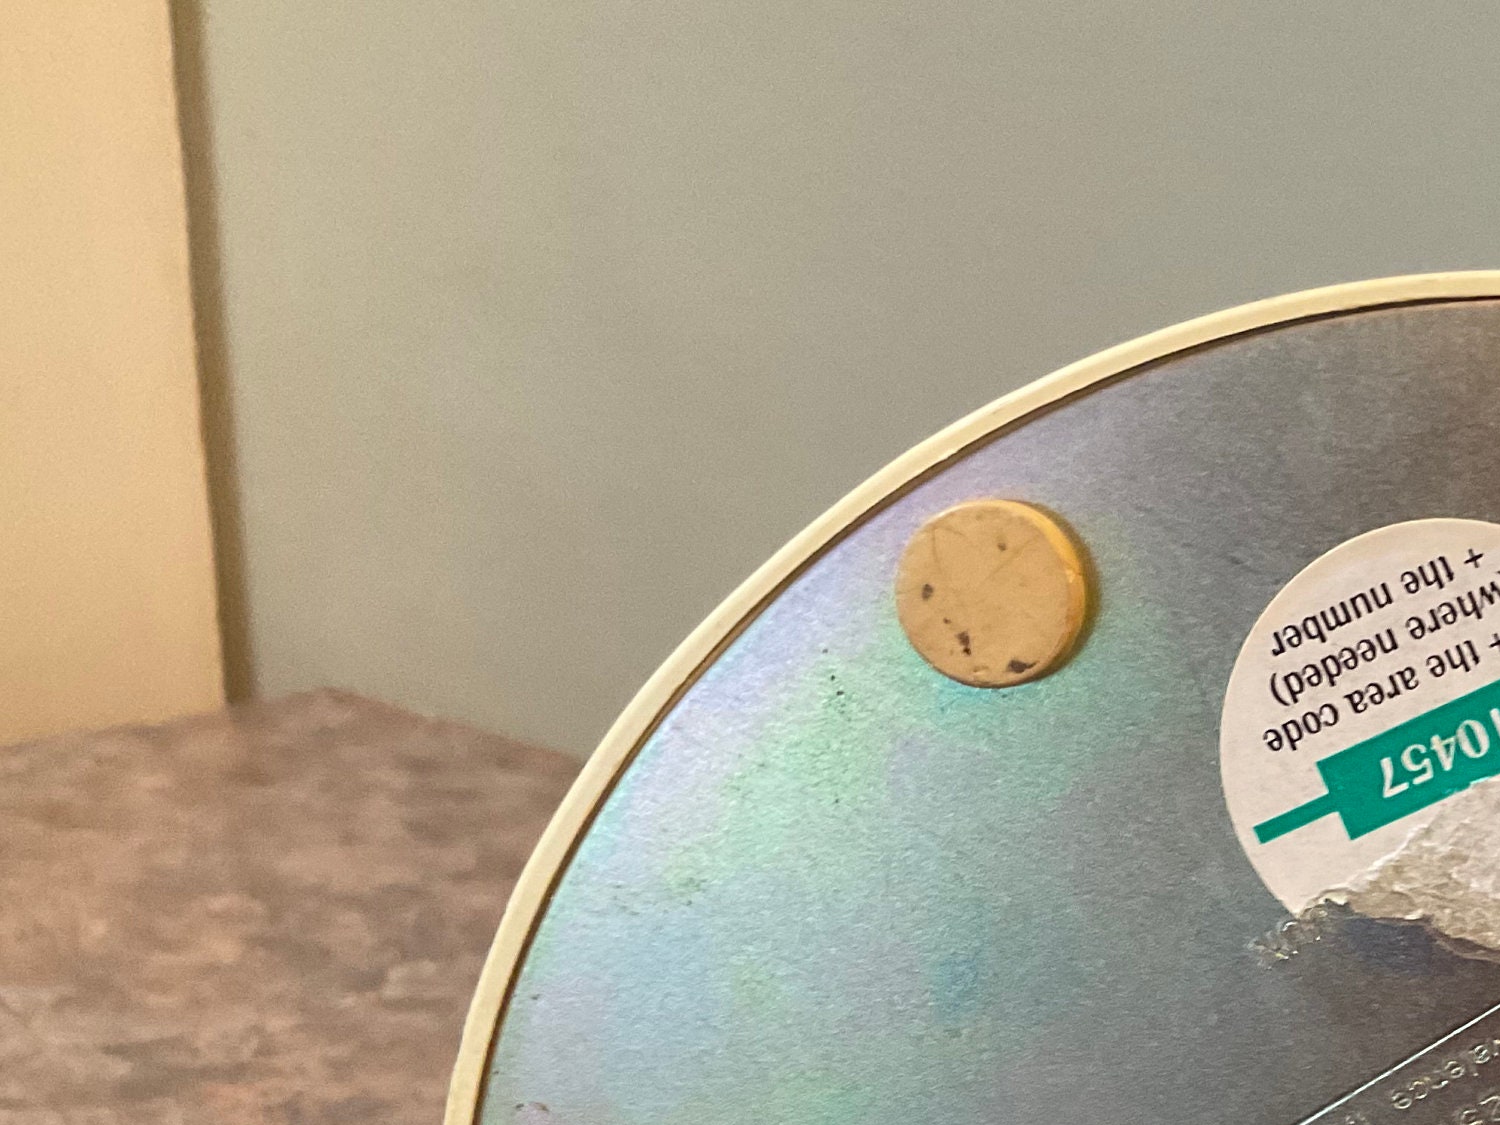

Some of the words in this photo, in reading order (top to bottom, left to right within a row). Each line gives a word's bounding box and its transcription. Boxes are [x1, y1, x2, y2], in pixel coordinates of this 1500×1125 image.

[1399, 555, 1456, 594] the
[1270, 581, 1395, 657] number
[1270, 628, 1400, 707] needed)
[1425, 639, 1481, 679] the
[1343, 665, 1420, 715] area
[1262, 702, 1340, 752] code
